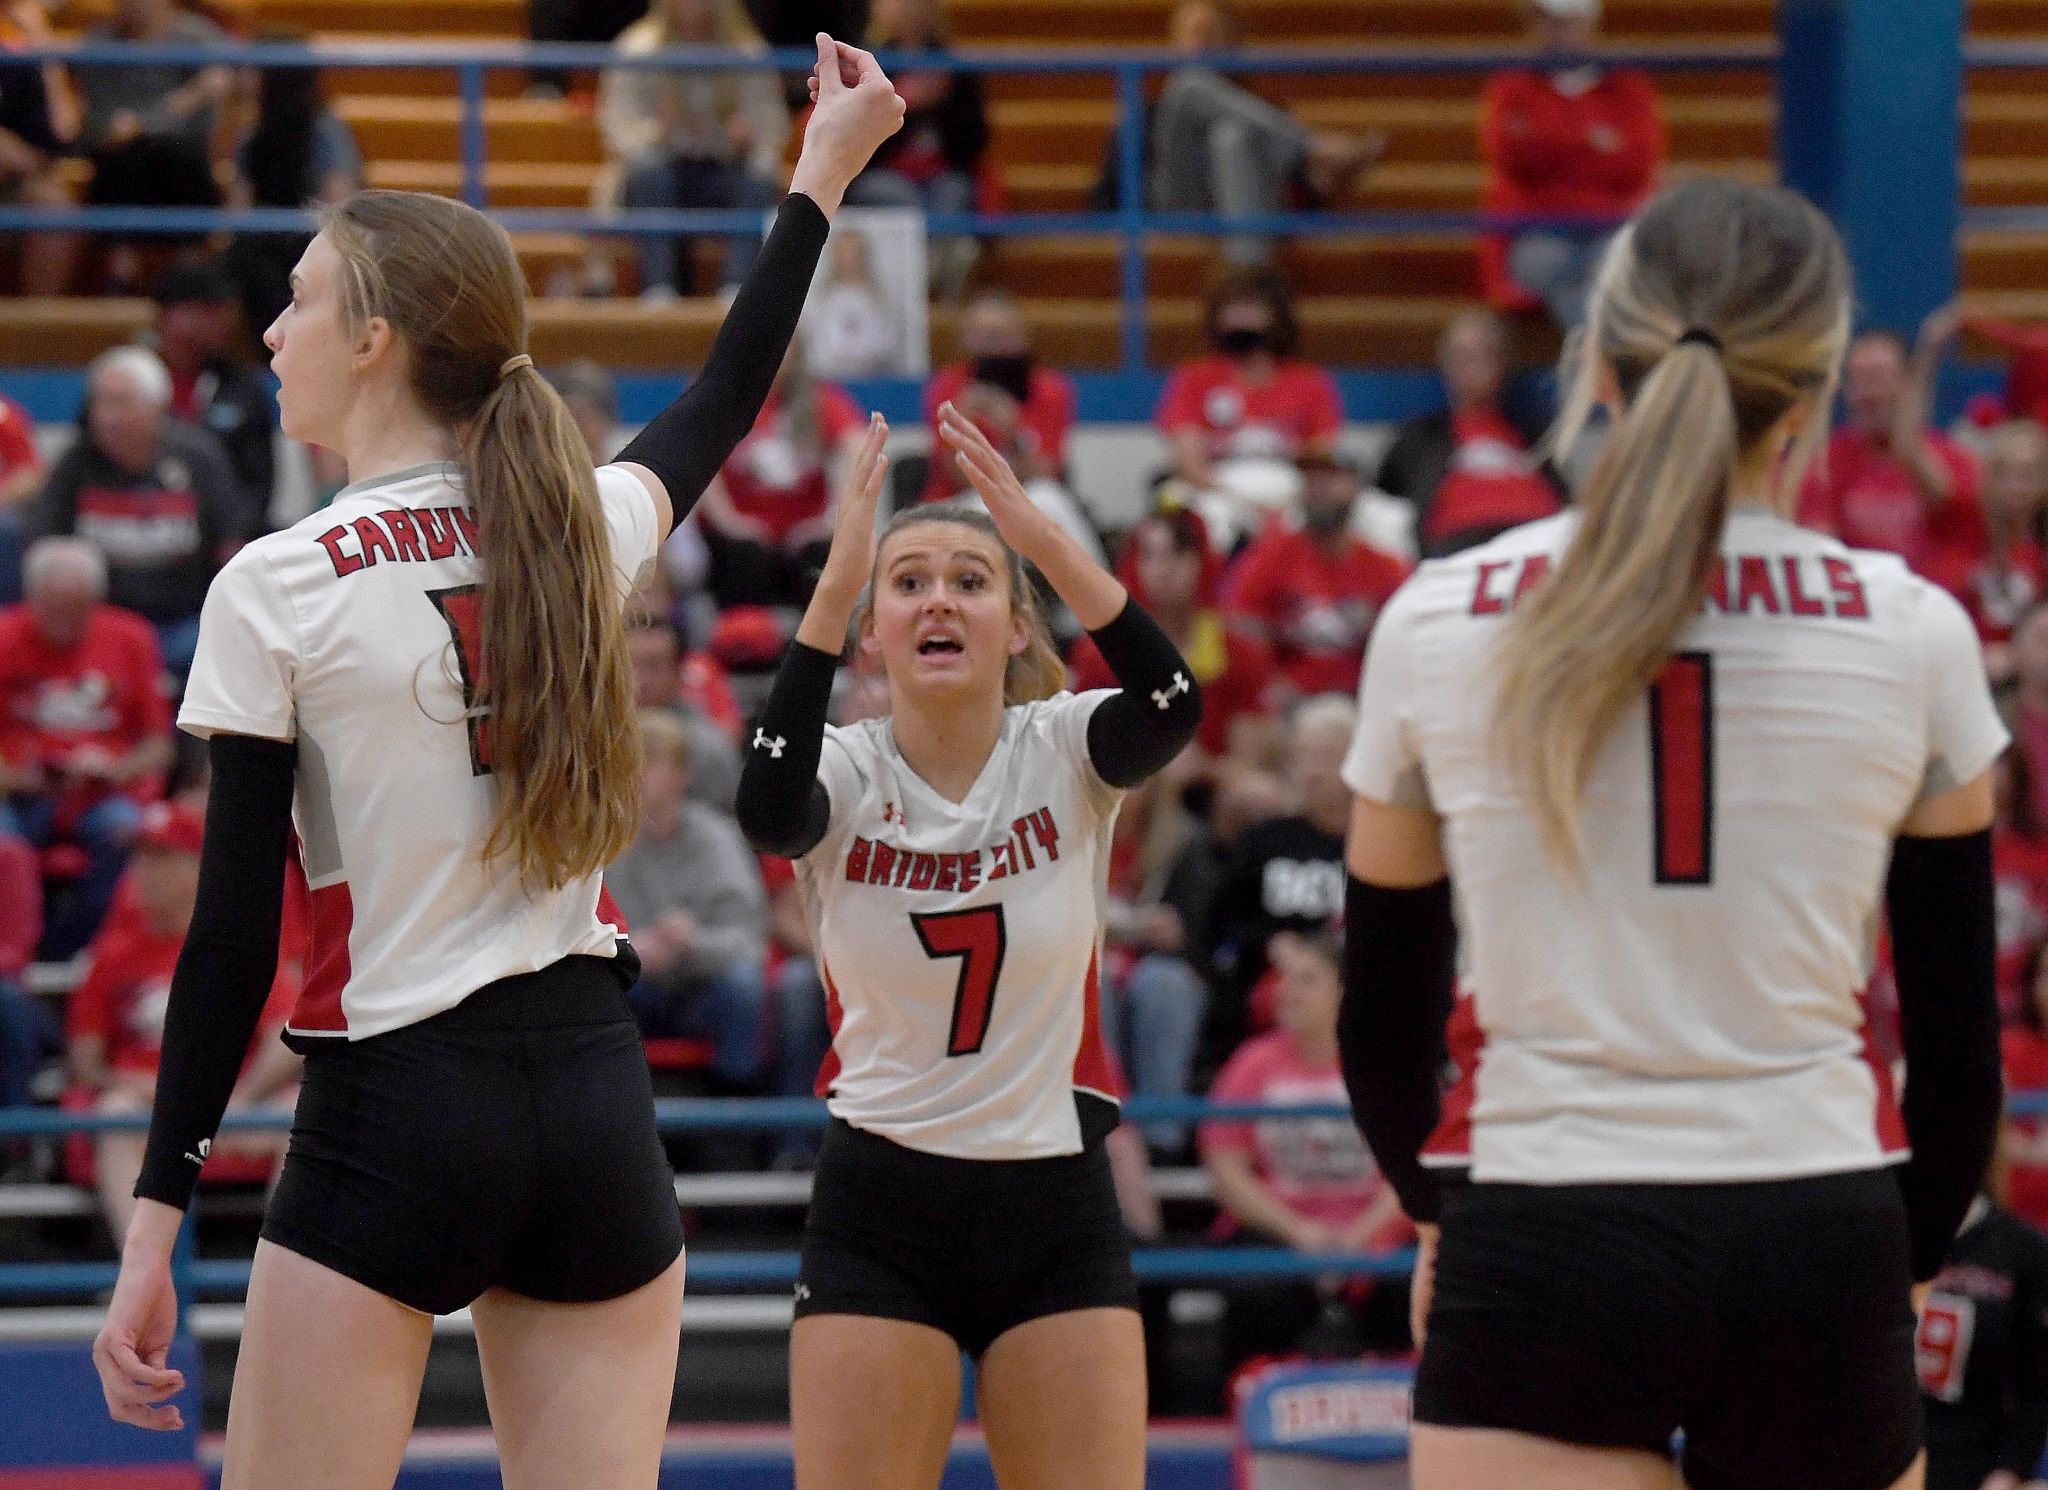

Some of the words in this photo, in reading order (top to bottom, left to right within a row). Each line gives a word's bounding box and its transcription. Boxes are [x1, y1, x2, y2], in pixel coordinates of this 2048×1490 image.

[1648, 651, 1711, 884] 1
[846, 835, 982, 892] BRIDGE
[988, 806, 1060, 881] CITY
[909, 903, 1007, 1057] 7
